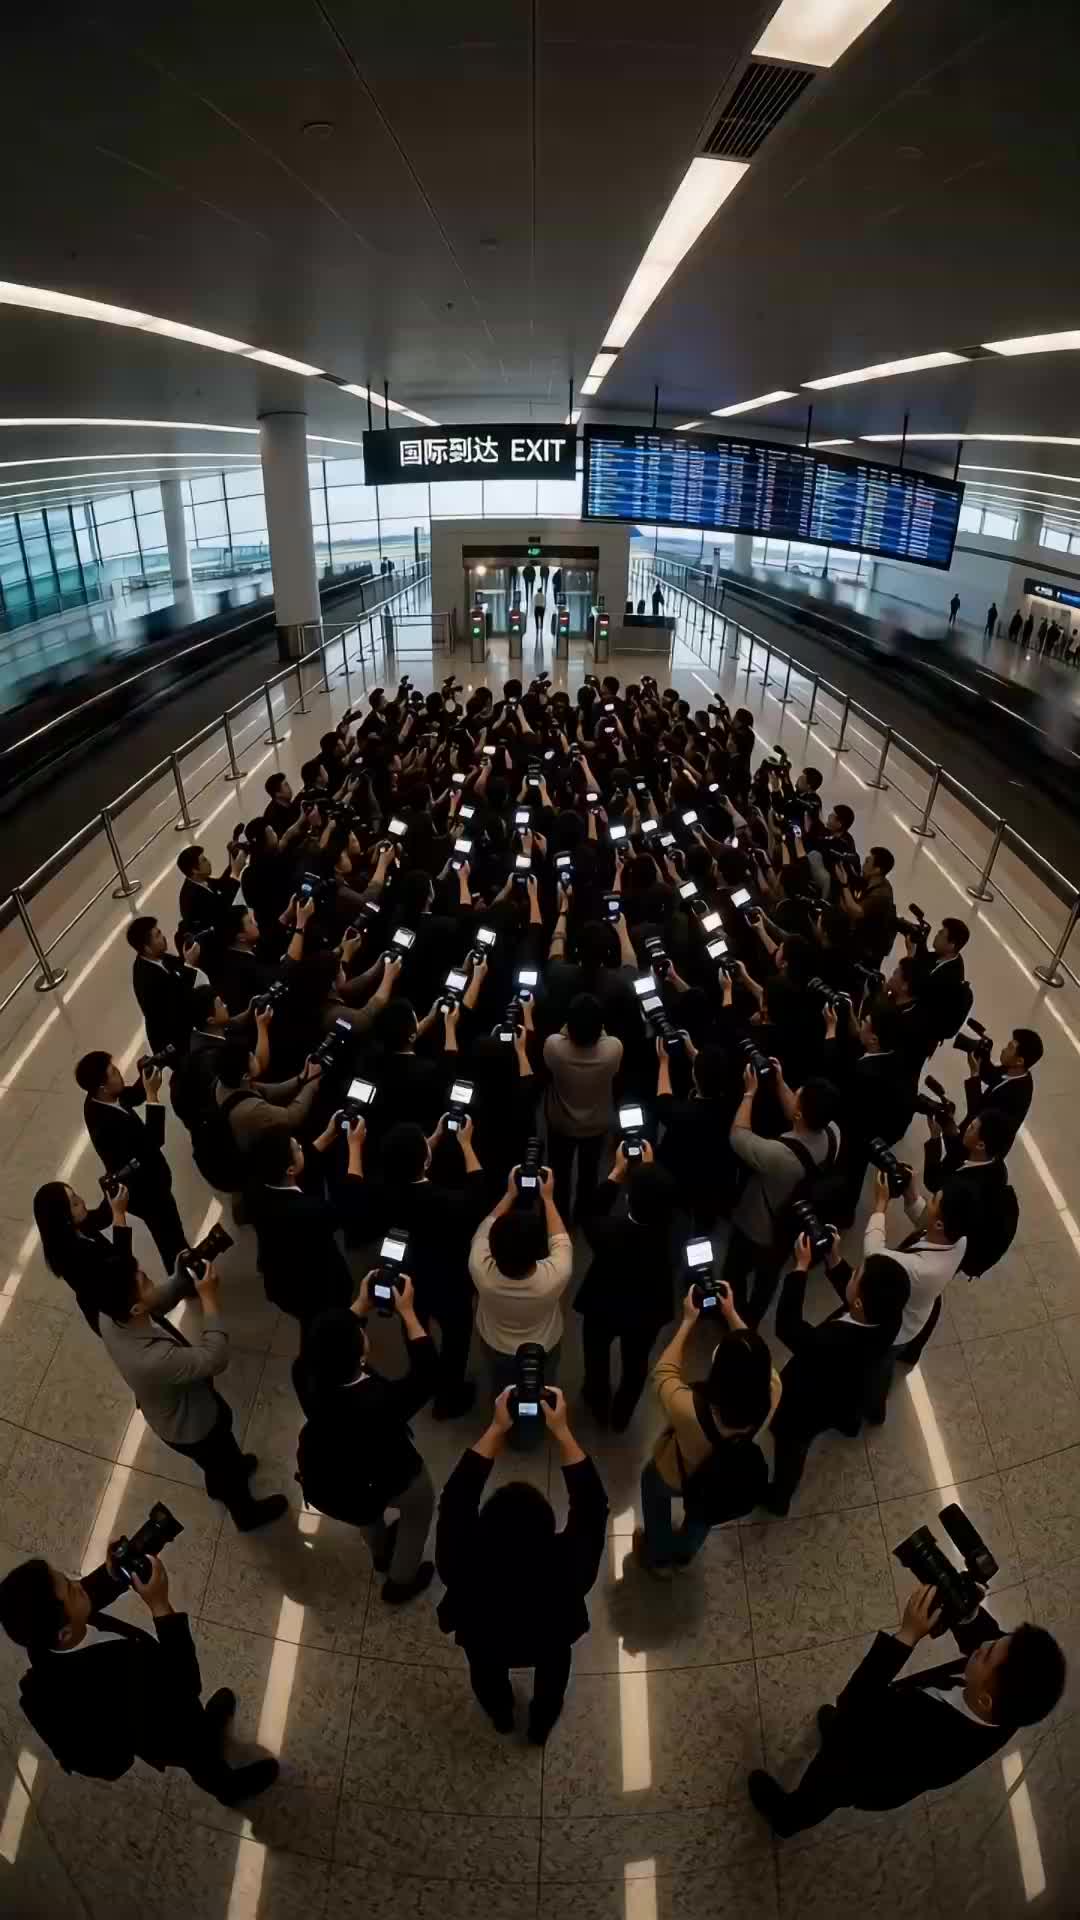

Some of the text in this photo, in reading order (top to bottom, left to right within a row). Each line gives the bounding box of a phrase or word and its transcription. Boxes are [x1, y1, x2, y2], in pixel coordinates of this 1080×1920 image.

[400, 436, 566, 466] 国际到达 EXIT
